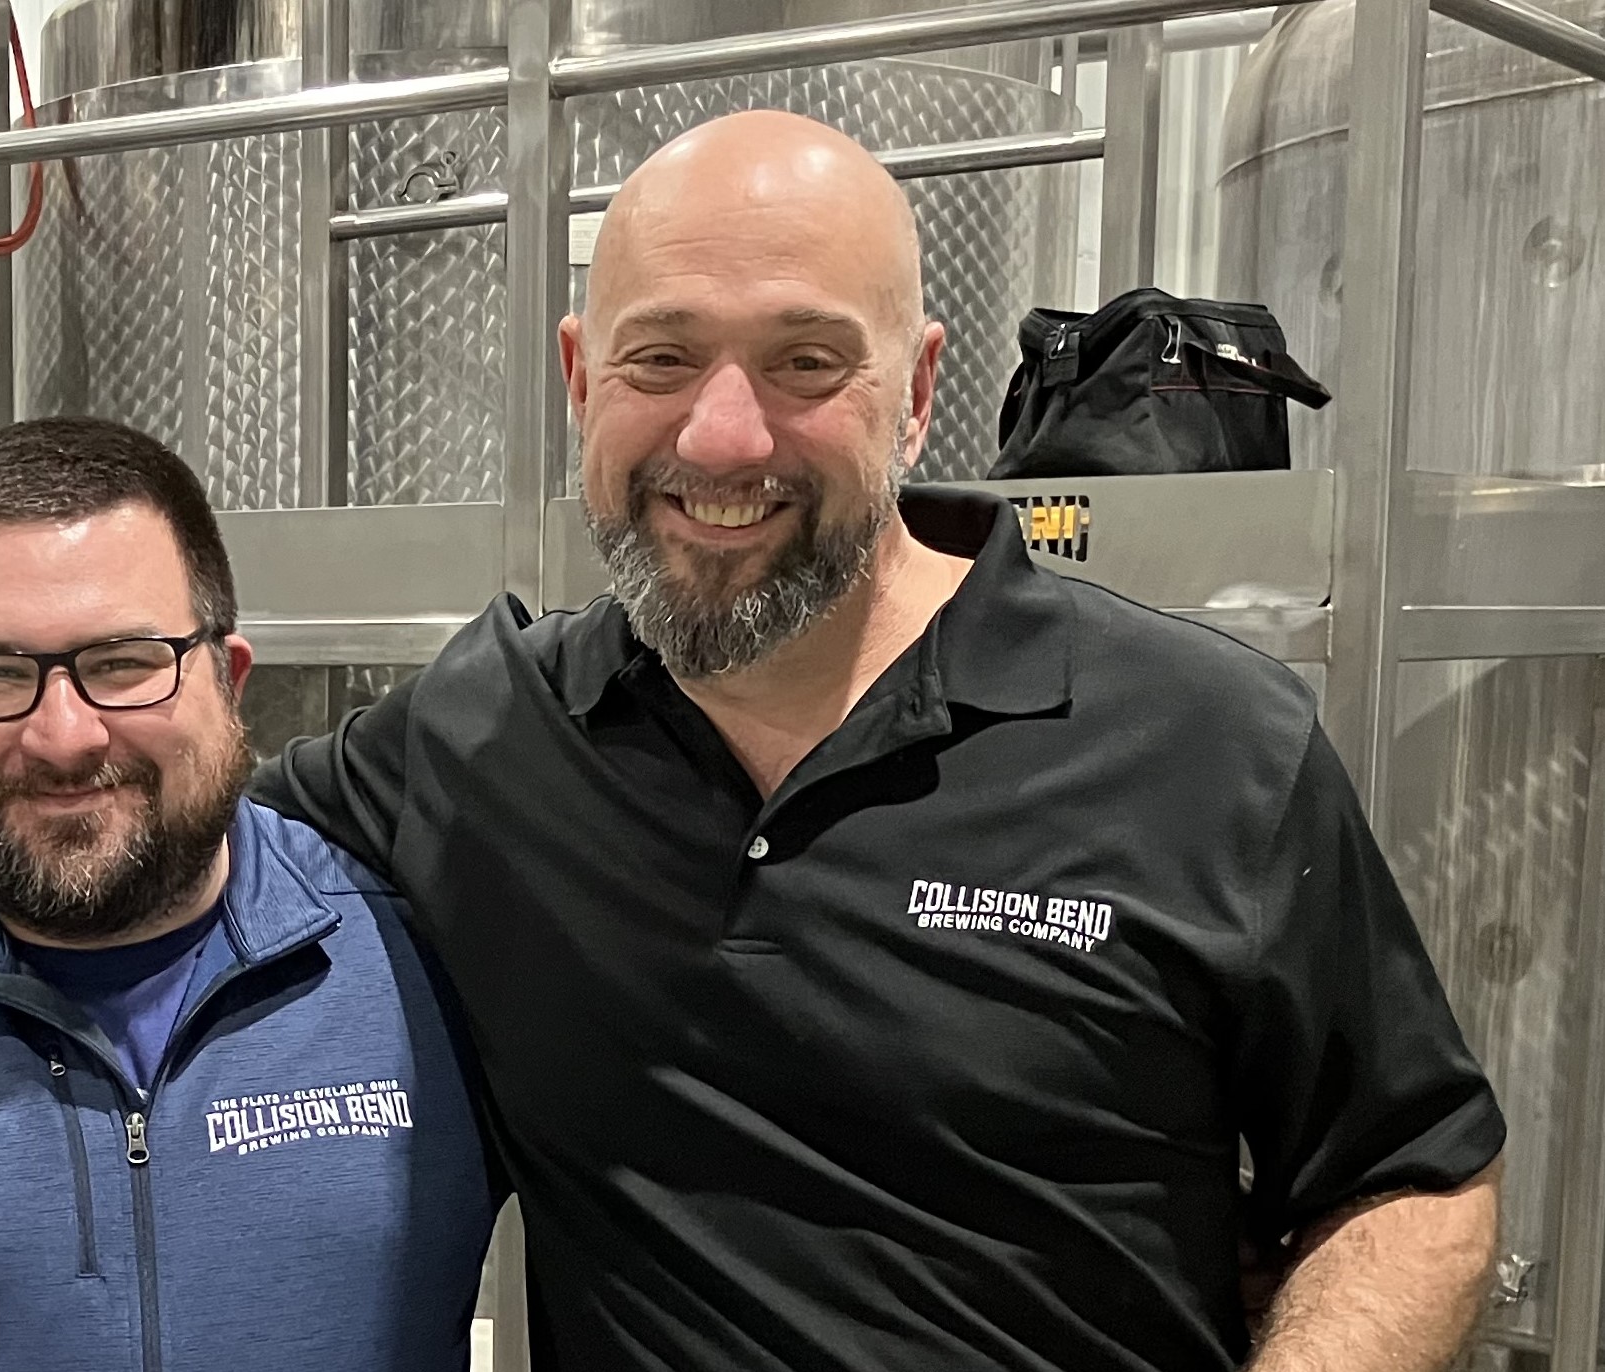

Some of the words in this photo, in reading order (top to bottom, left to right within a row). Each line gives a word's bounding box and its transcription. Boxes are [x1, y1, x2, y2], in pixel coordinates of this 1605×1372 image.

[906, 879, 1040, 921] COLLISION
[1045, 897, 1113, 941] BEND
[917, 913, 1003, 932] BREWING
[1008, 918, 1096, 952] COMPANY
[212, 1098, 238, 1111] THE
[293, 1083, 365, 1101] CLEVELAND
[369, 1079, 399, 1091] OHIO
[205, 1097, 342, 1152] COLLISION
[345, 1091, 414, 1128] BEND
[237, 1129, 311, 1155] BREWING
[316, 1124, 390, 1138] COMPANY
